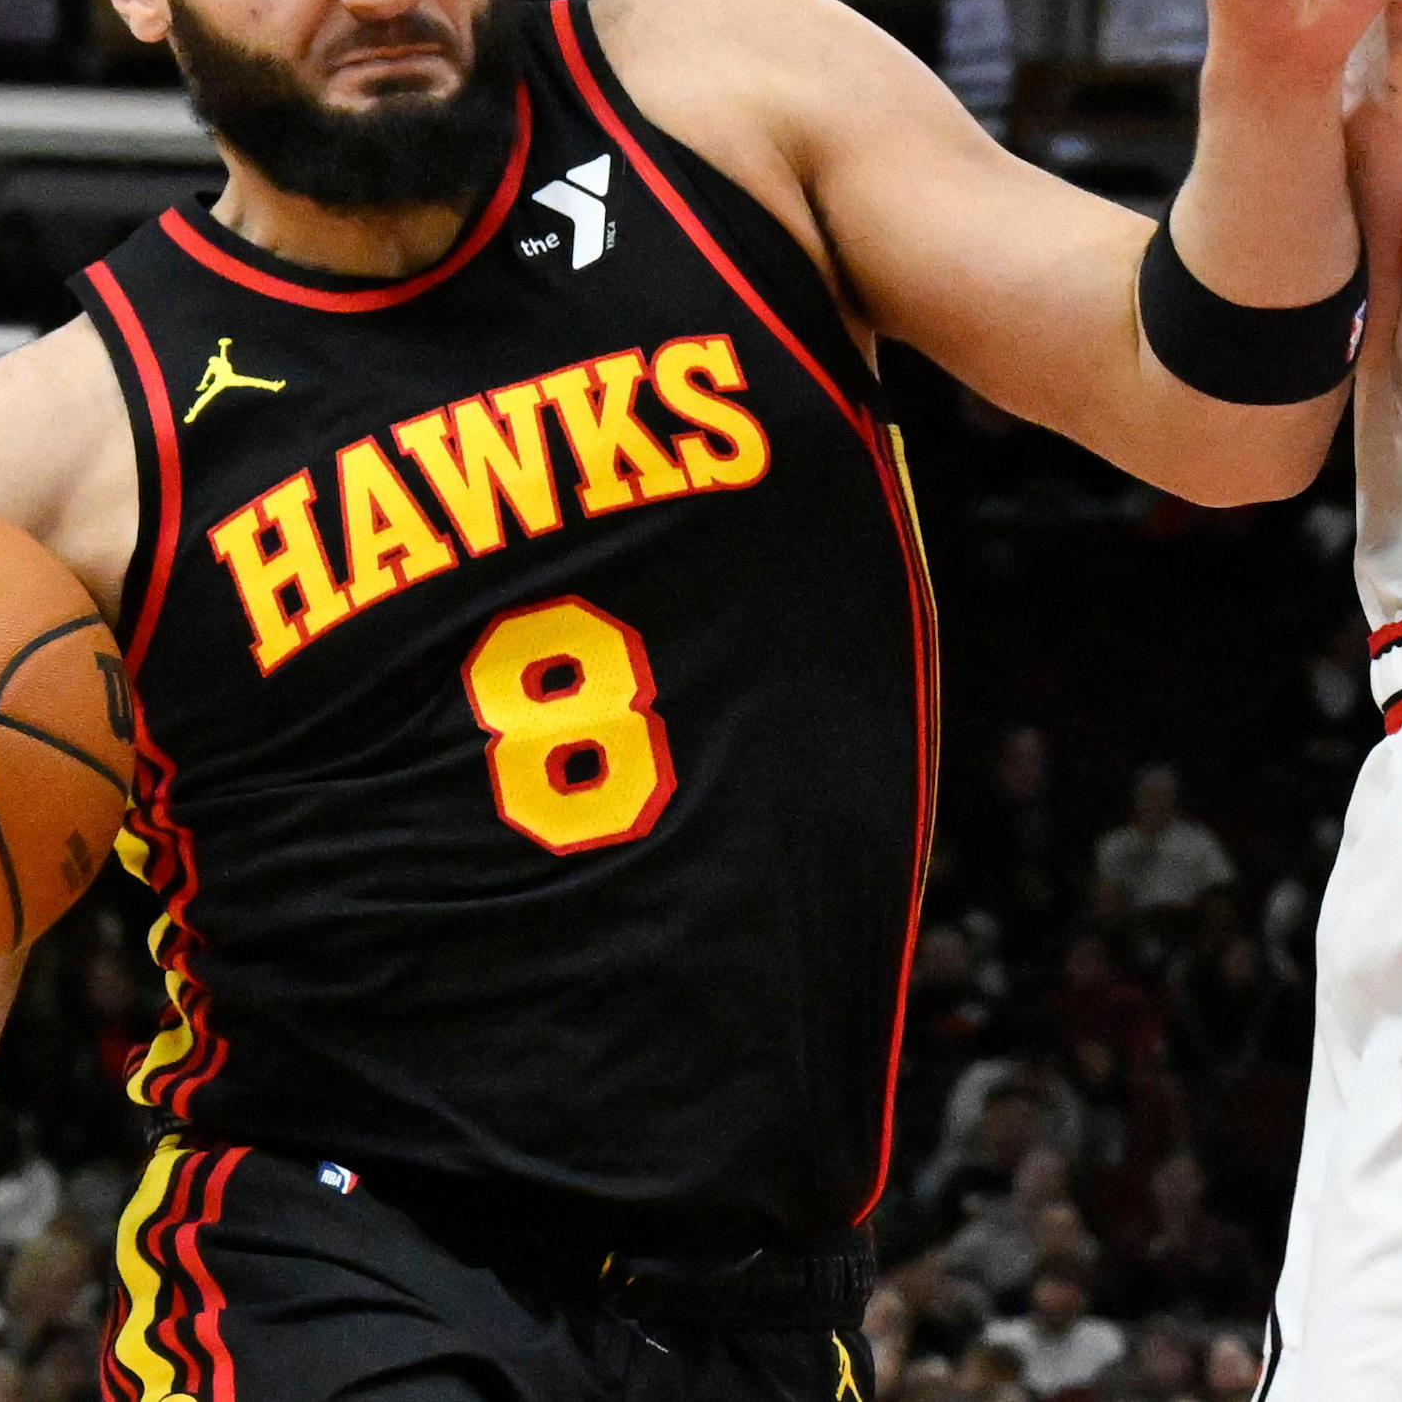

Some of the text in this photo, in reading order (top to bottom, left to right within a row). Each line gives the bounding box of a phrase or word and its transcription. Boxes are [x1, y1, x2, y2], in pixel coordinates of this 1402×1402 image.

[520, 232, 560, 257] the
[207, 333, 770, 678] HAWKS
[461, 593, 676, 856] 8
